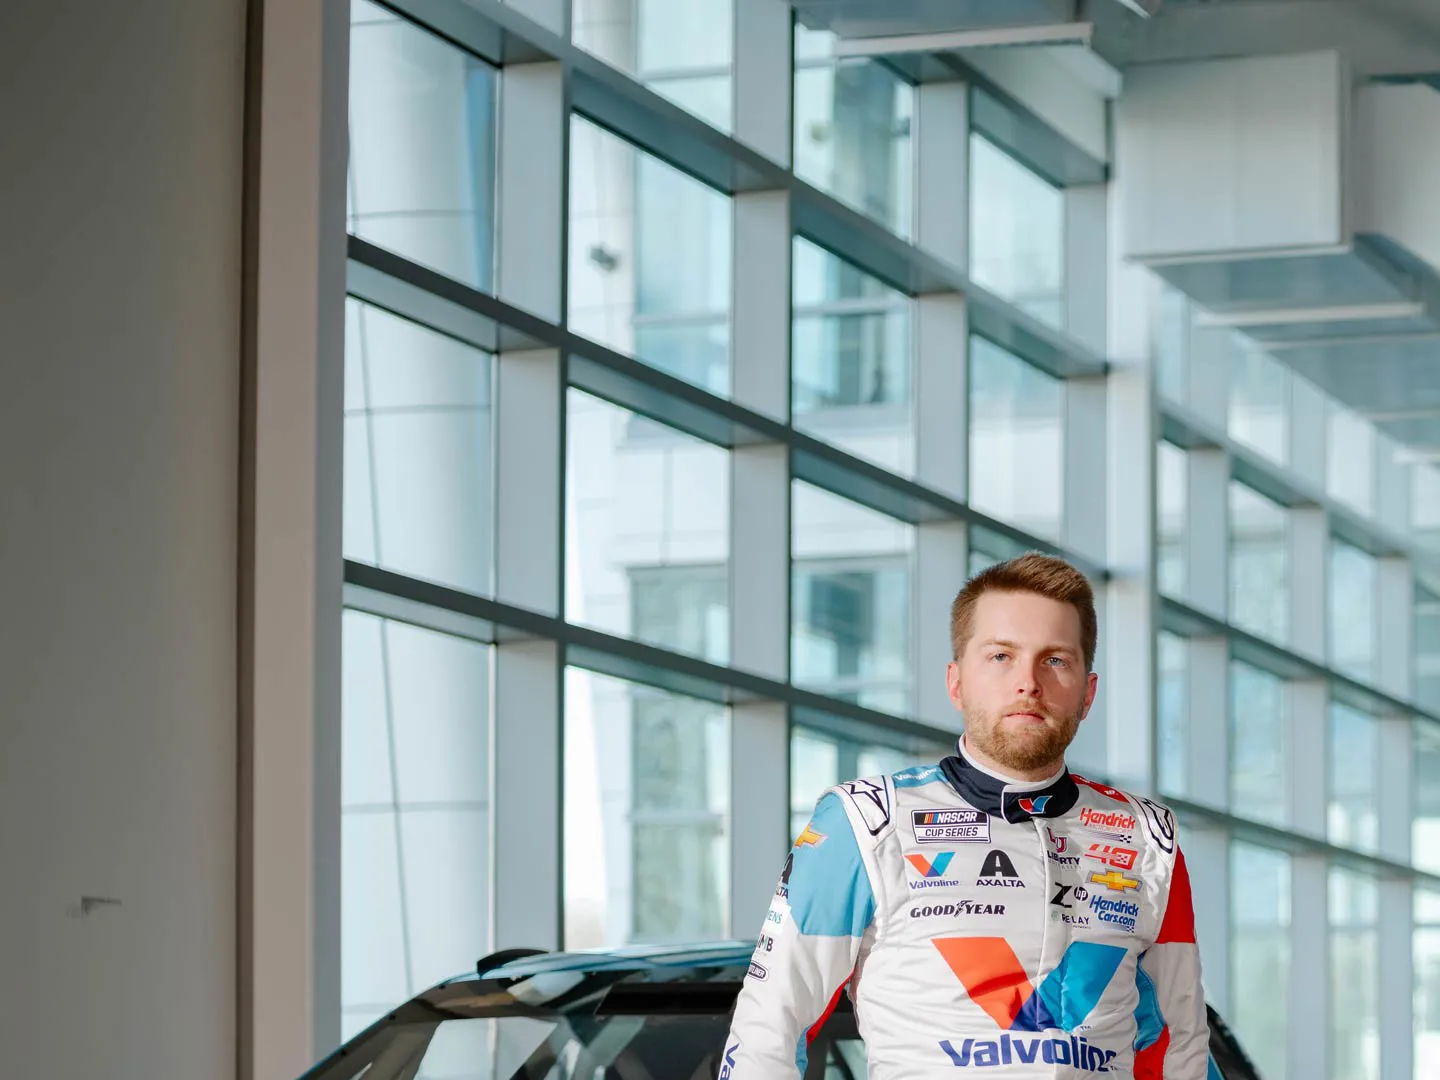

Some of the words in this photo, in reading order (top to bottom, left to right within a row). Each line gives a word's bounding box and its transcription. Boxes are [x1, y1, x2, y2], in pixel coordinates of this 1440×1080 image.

[937, 812, 977, 823] NASCAR
[1079, 807, 1136, 830] Hendrick
[925, 828, 943, 837] CUP
[945, 827, 978, 837] SERIES
[909, 879, 959, 890] Valvoline
[976, 879, 1026, 888] AXALTA
[1075, 887, 1087, 900] hp
[1089, 894, 1139, 917] Hendrick
[1061, 913, 1090, 925] RELAY
[1097, 910, 1136, 928] Cars.com
